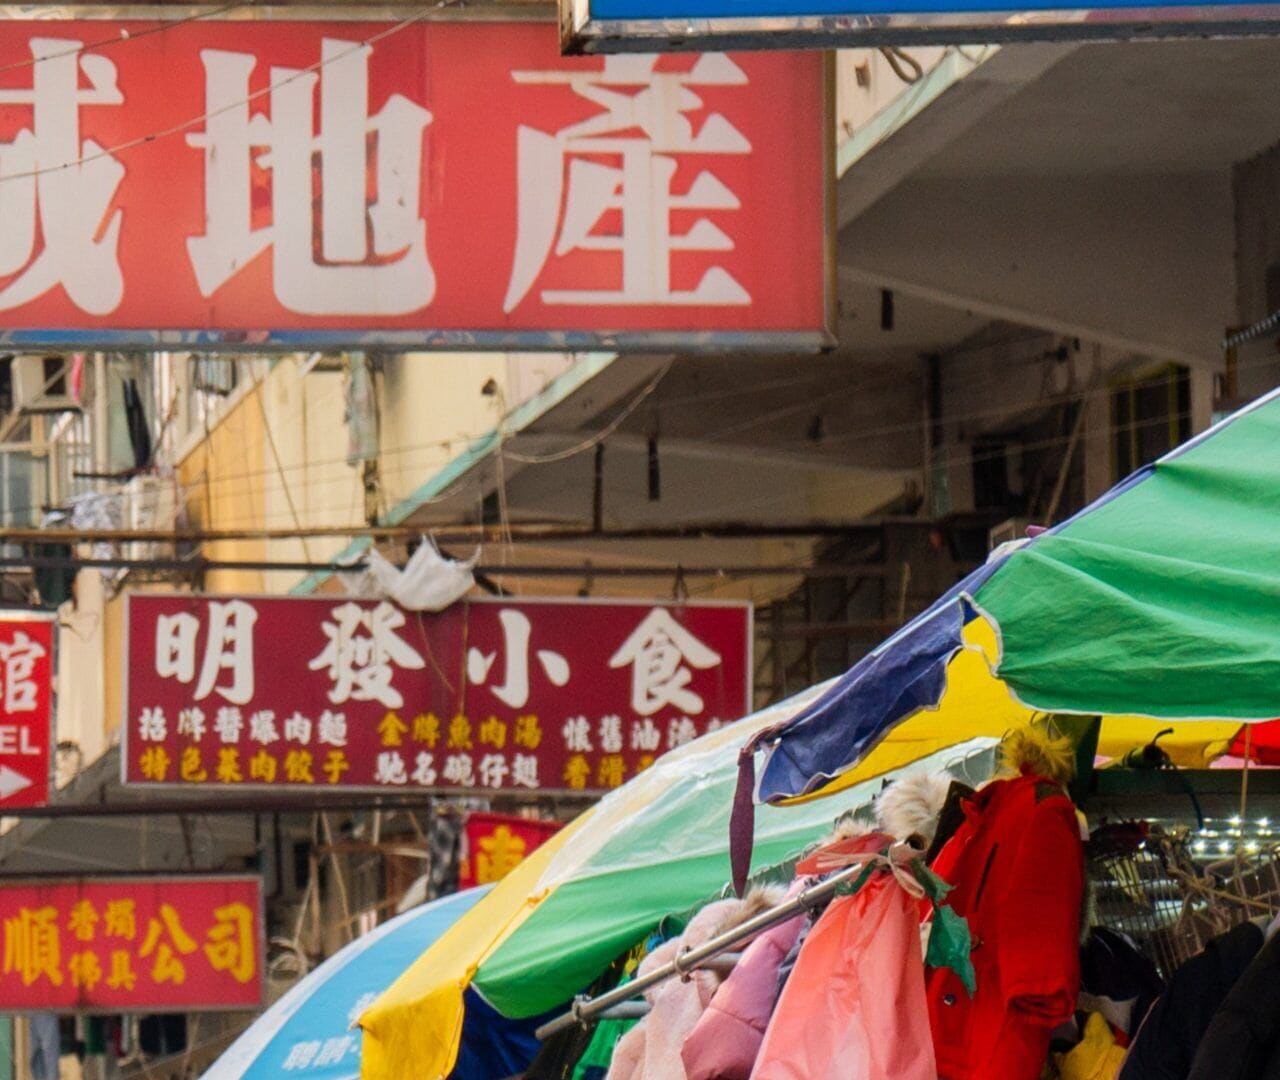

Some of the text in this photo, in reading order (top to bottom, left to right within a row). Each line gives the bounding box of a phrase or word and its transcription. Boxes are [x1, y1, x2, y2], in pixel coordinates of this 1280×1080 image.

[154, 599, 722, 716] 明發小食
[140, 901, 256, 986] 公司
